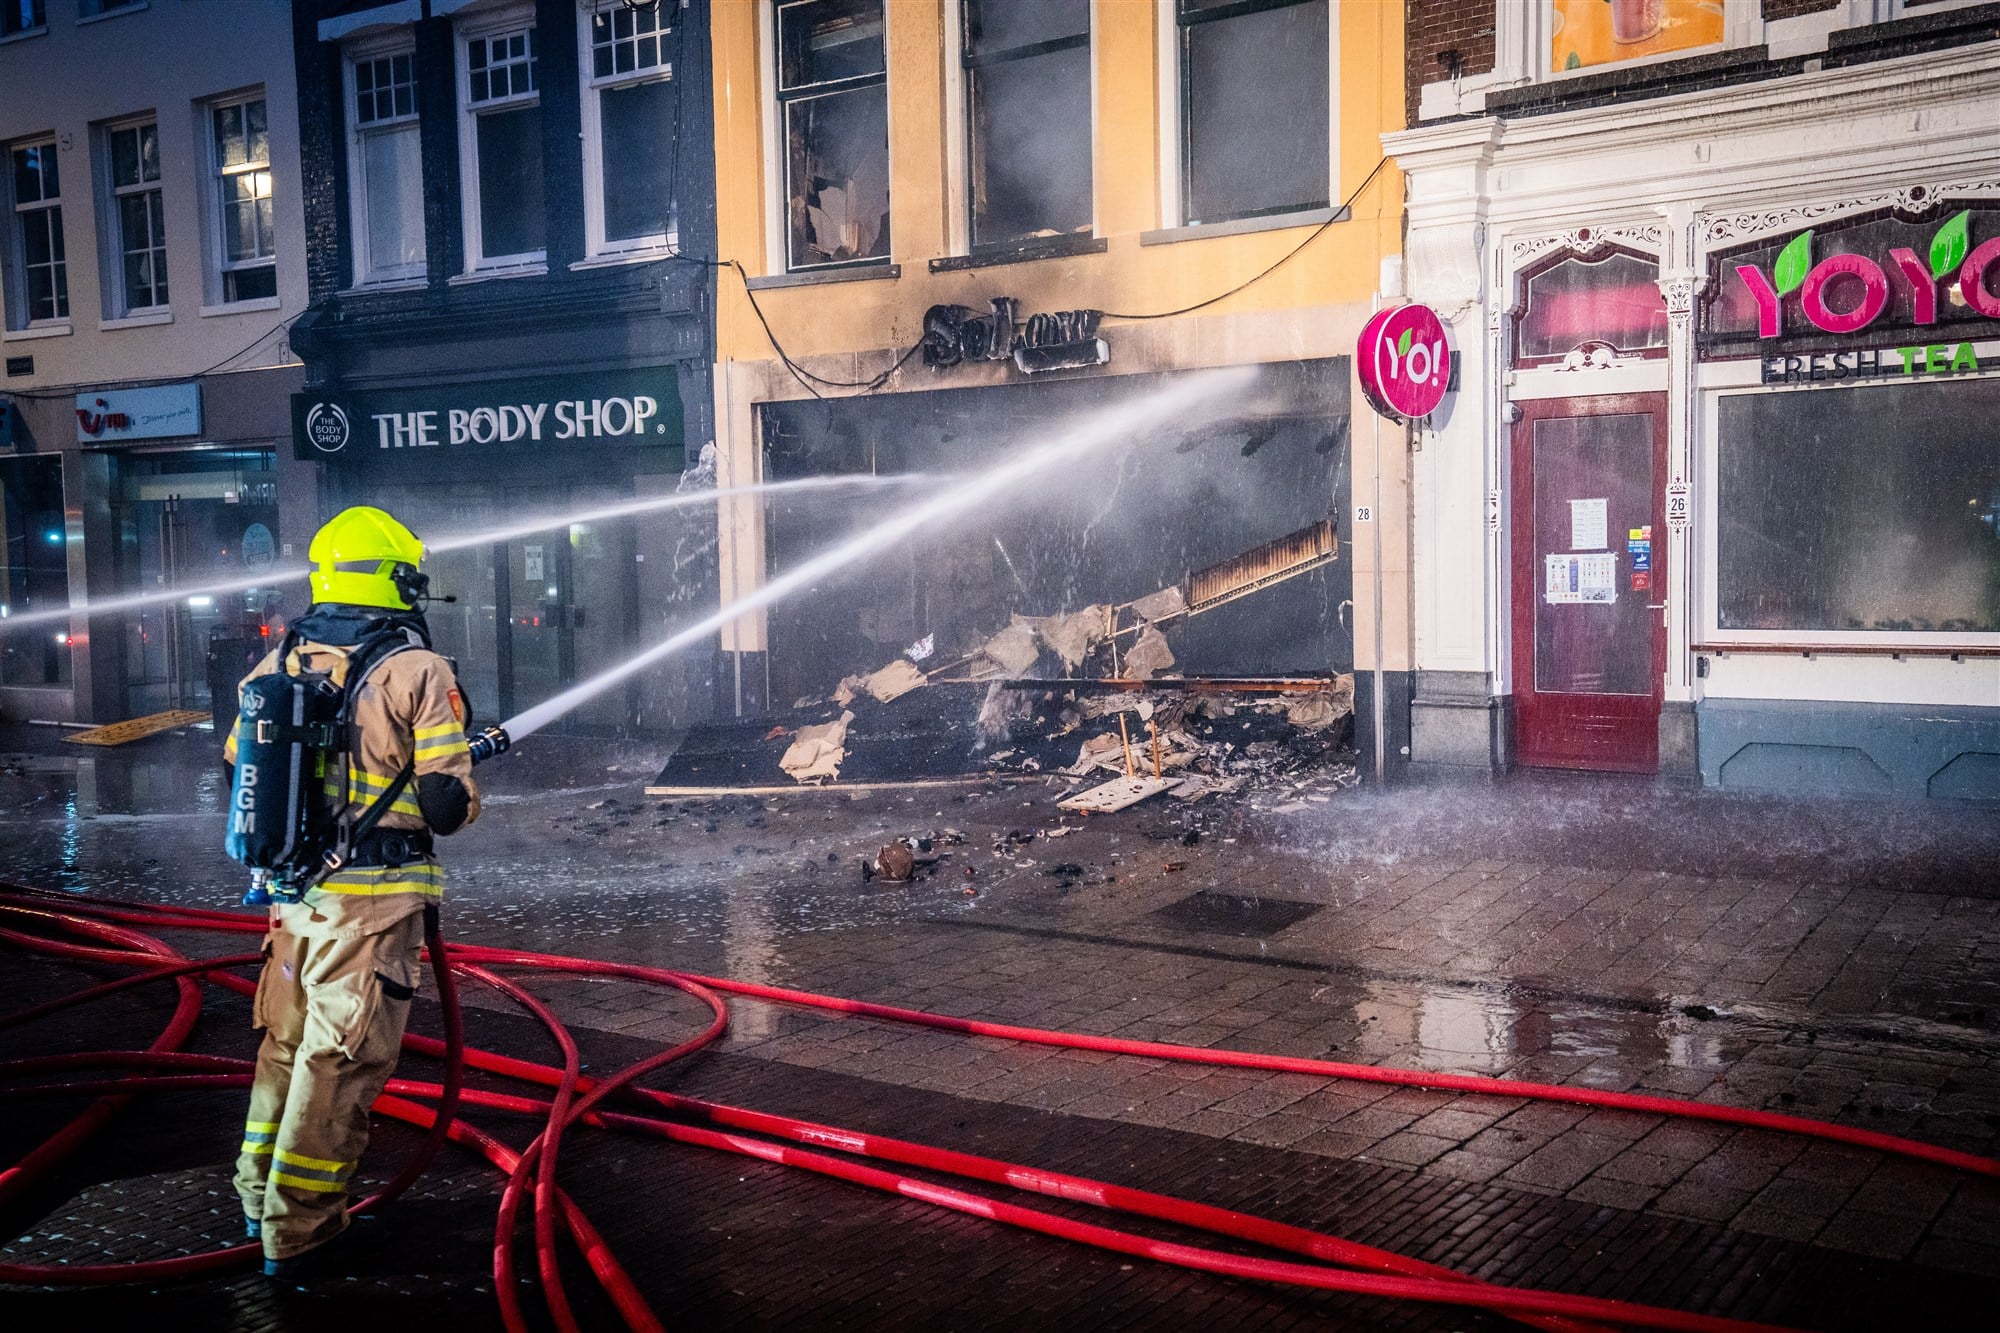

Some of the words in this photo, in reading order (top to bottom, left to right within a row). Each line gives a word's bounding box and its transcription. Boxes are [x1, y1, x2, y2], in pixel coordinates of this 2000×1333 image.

[1384, 327, 1443, 387] YO!
[1761, 350, 1881, 384] FRESH
[1896, 342, 1979, 377] TEA
[319, 417, 336, 425] THE
[371, 410, 440, 449] THE
[449, 402, 549, 445] BODY
[554, 396, 657, 440] SHOP
[315, 425, 341, 434] BODY
[317, 434, 341, 443] SHOP
[1671, 498, 1685, 511] 26
[1358, 508, 1370, 521] 28
[233, 764, 259, 834] BGM
